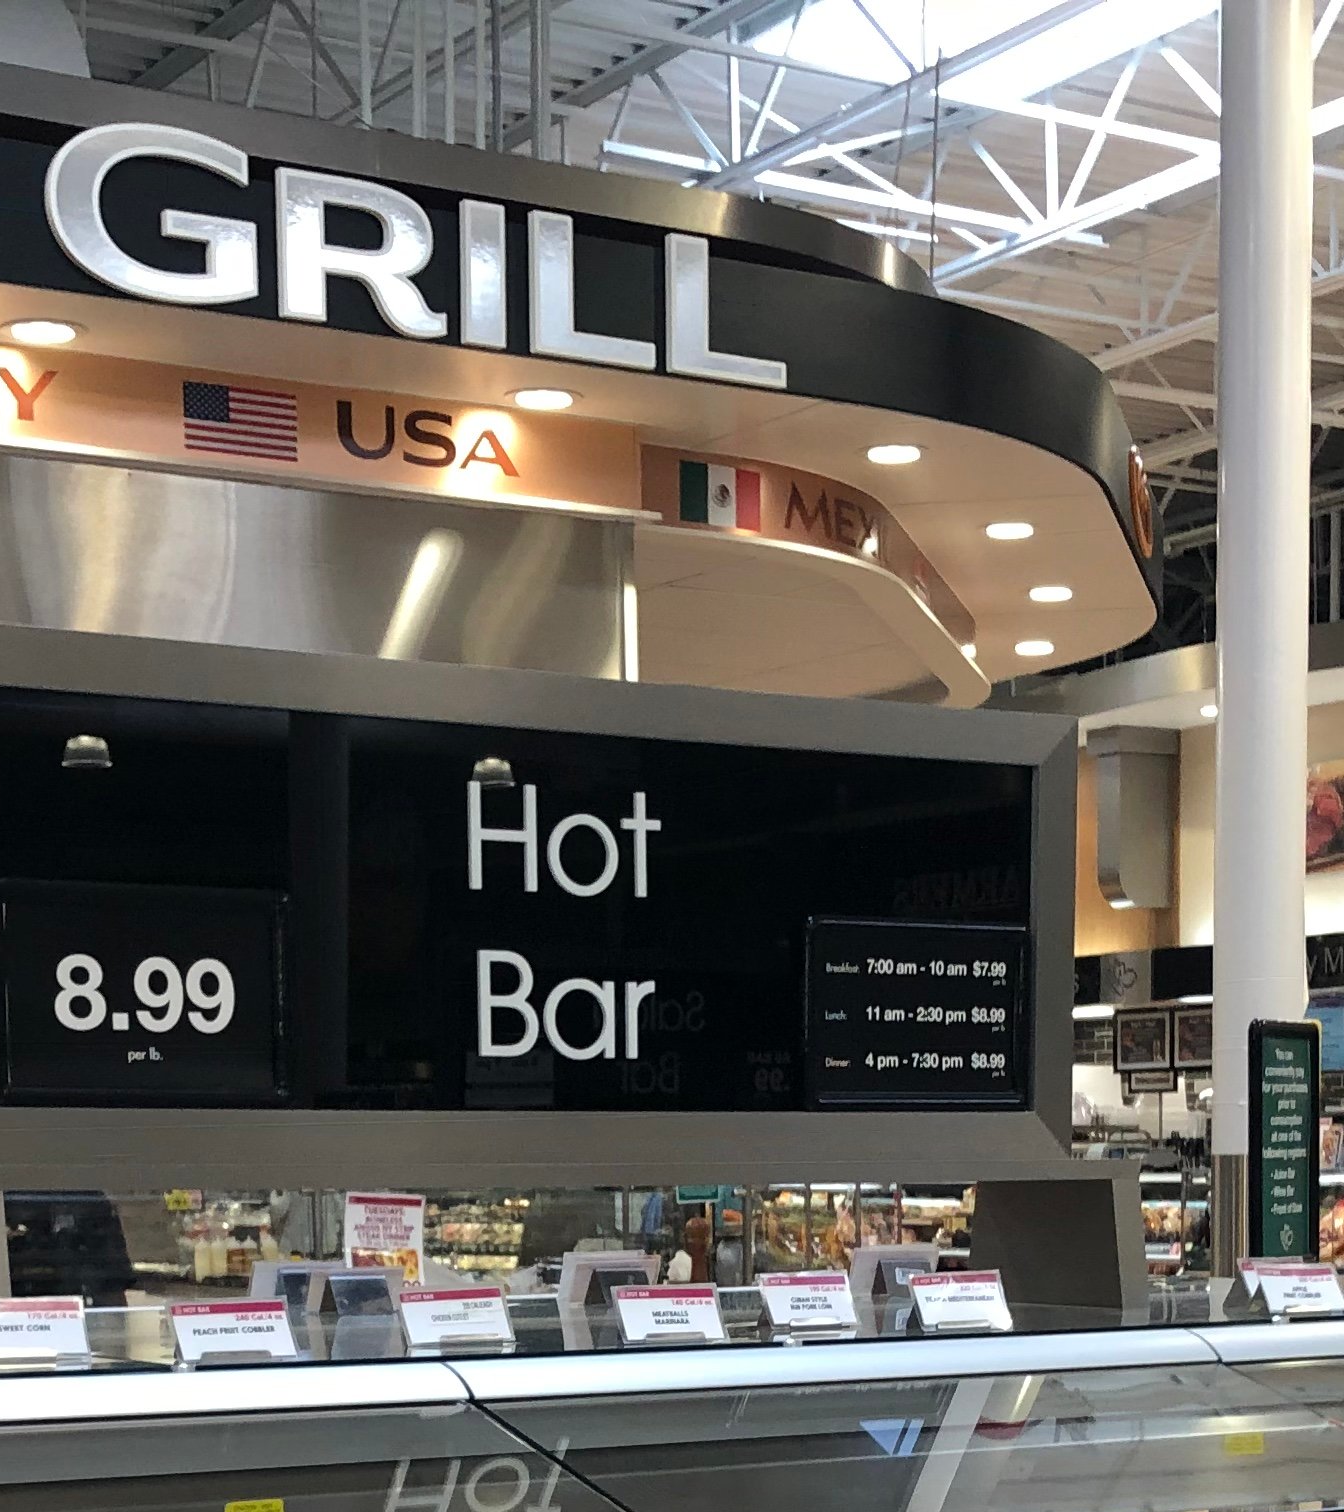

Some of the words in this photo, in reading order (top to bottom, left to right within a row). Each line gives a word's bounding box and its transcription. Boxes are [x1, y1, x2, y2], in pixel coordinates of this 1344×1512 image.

[44, 122, 787, 388] GRILL
[336, 400, 519, 478] USA
[466, 781, 662, 899] Hot
[866, 958, 894, 976] 7:00
[896, 962, 917, 976] am
[929, 960, 945, 976] 10
[947, 963, 968, 977] am
[972, 961, 1007, 978] $7.99
[54, 953, 236, 1035] 8.99
[476, 948, 656, 1061] Bar
[866, 1006, 881, 1022] 11
[884, 1009, 905, 1022] am
[916, 1006, 943, 1023] 2:30
[945, 1010, 967, 1026] pm
[971, 1007, 1006, 1024] $8.99
[127, 1050, 150, 1065] per
[152, 1047, 164, 1062] lb.
[865, 1052, 874, 1067] 4
[877, 1055, 899, 1071] pm
[911, 1053, 940, 1069] 7:30
[942, 1056, 964, 1072] pm
[971, 1052, 1006, 1069] $8.99
[26, 1324, 51, 1333] CORN
[192, 1327, 219, 1337] PEACH
